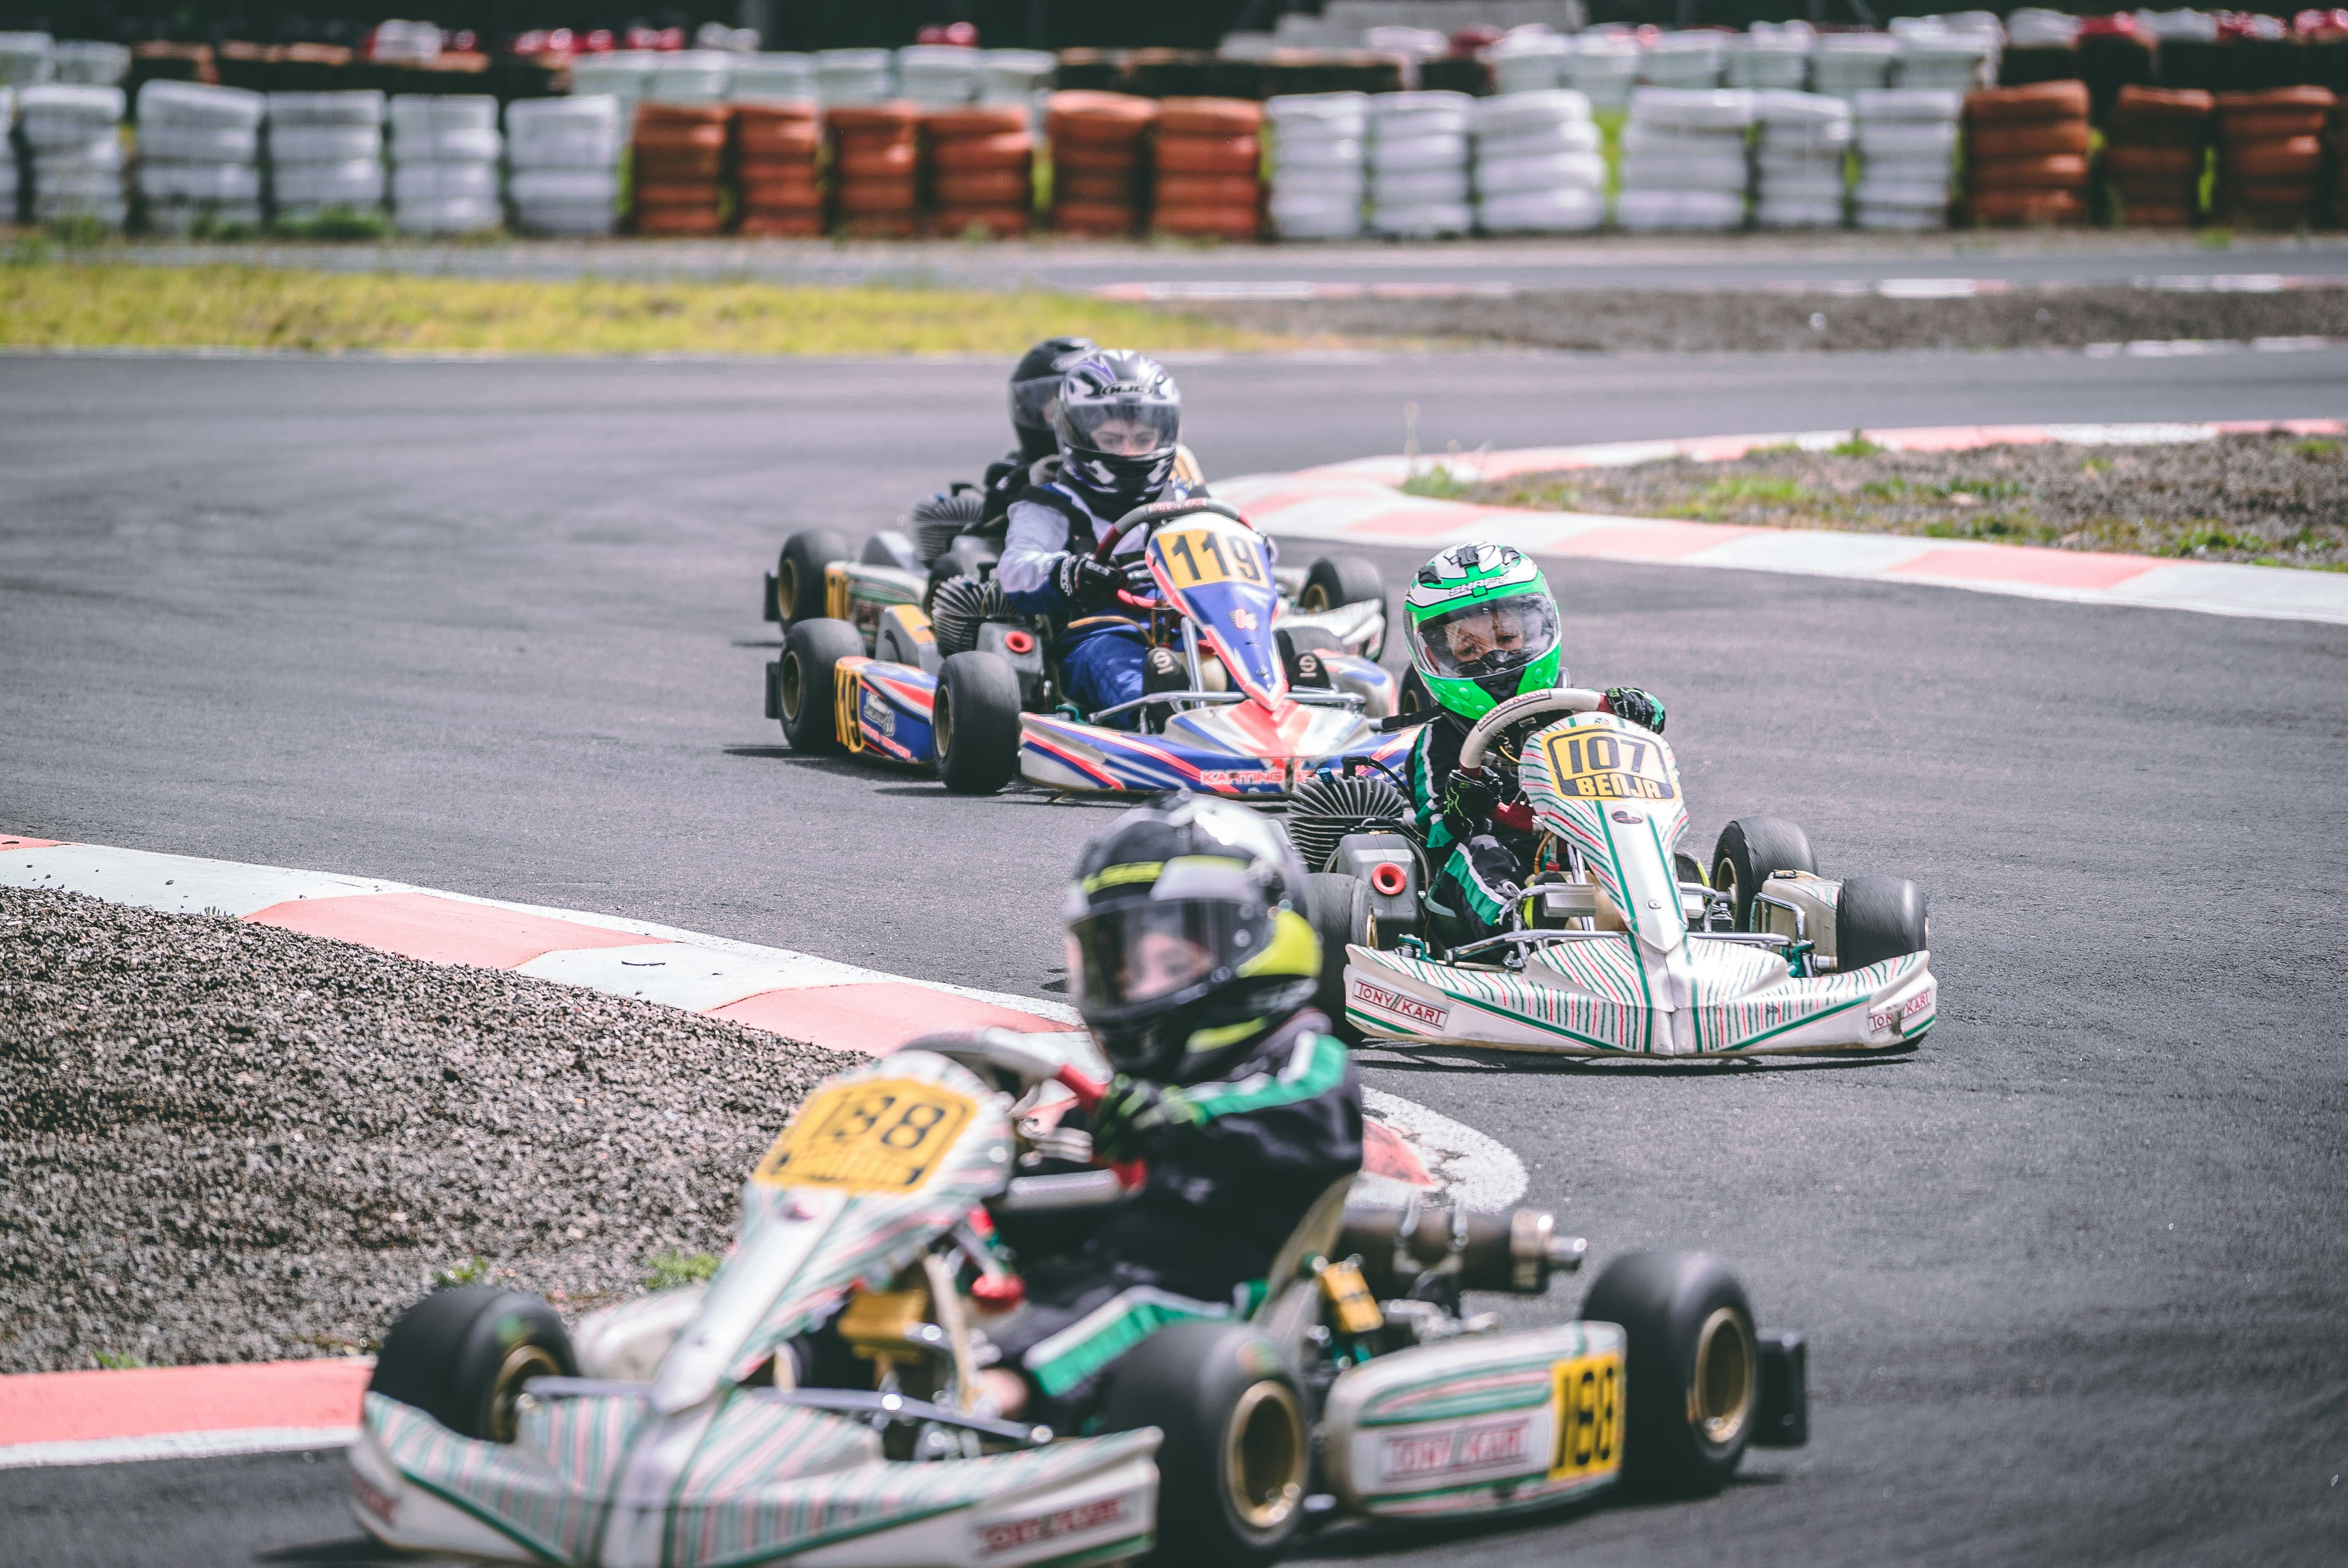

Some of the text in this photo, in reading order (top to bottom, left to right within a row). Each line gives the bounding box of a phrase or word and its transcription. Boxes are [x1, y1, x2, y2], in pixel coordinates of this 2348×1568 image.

[1109, 385, 1145, 394] HJC
[1171, 532, 1261, 581] 119
[1448, 575, 1508, 597] SHAFT
[1568, 736, 1646, 773] 107
[1201, 771, 1284, 785] KARTING
[1575, 772, 1662, 799] BENJA
[1357, 981, 1446, 1024] TONY KART
[1868, 1012, 1893, 1029] TON
